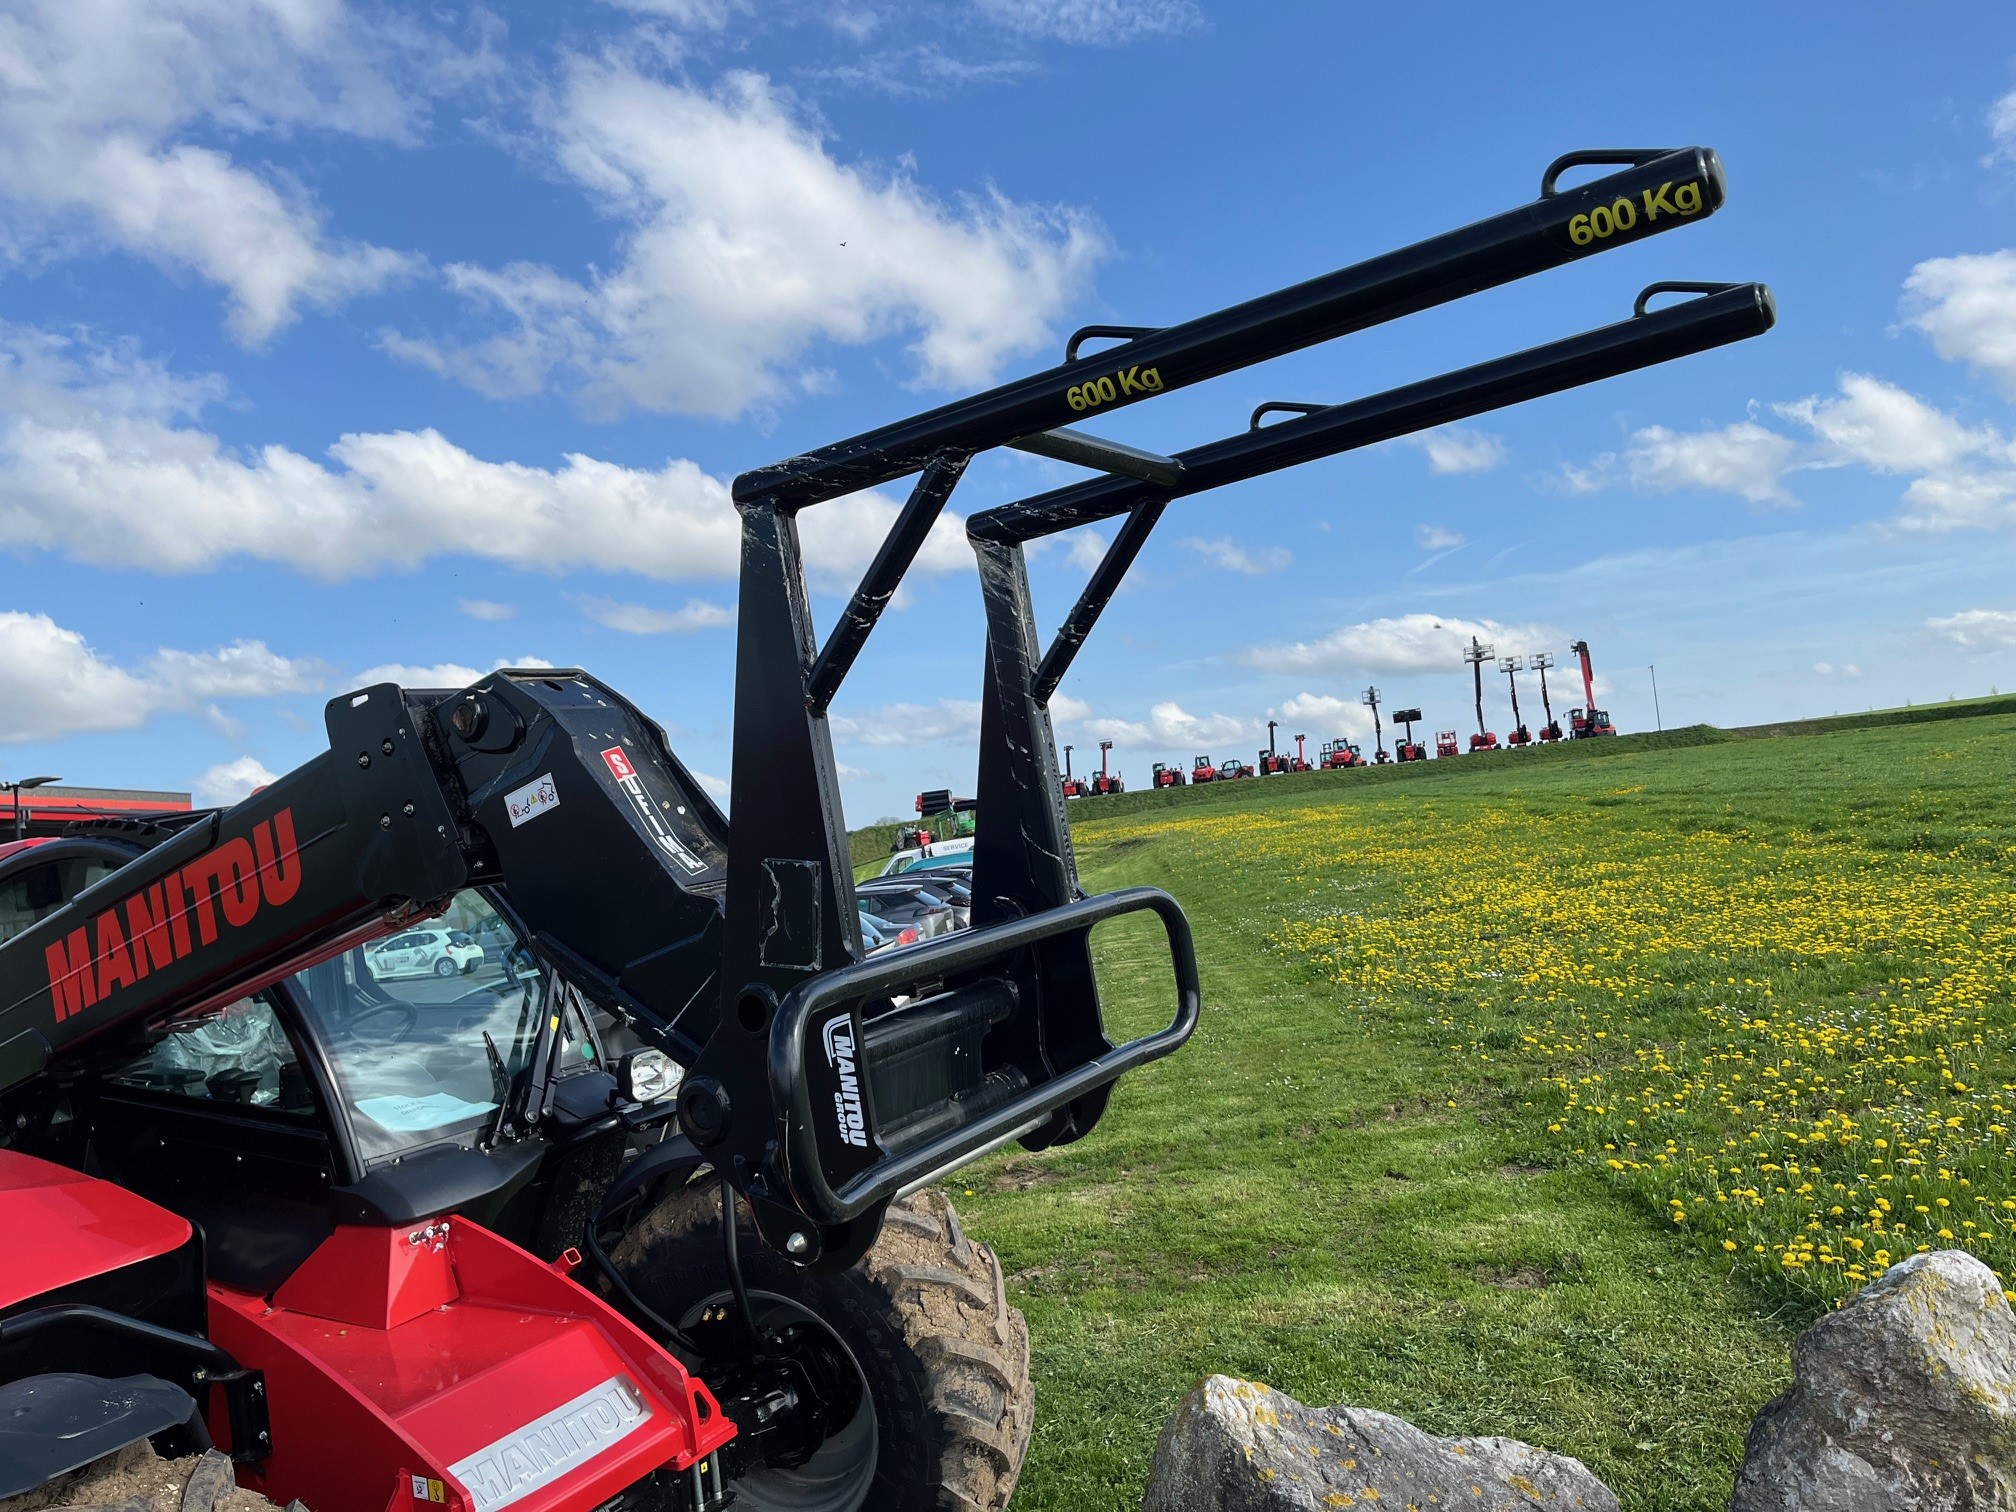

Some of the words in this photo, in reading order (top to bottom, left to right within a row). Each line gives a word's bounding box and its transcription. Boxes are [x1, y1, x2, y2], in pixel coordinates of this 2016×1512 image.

[1569, 198, 1636, 245] 600
[1642, 182, 1702, 221] Kg
[1067, 377, 1116, 411] 600
[1118, 366, 1164, 396] Kg
[943, 843, 969, 851] SERVICE
[45, 807, 301, 1023] MANITOU
[833, 1035, 867, 1147] MANITOU
[834, 1092, 849, 1144] GROUP
[456, 1386, 643, 1508] MANITOU
